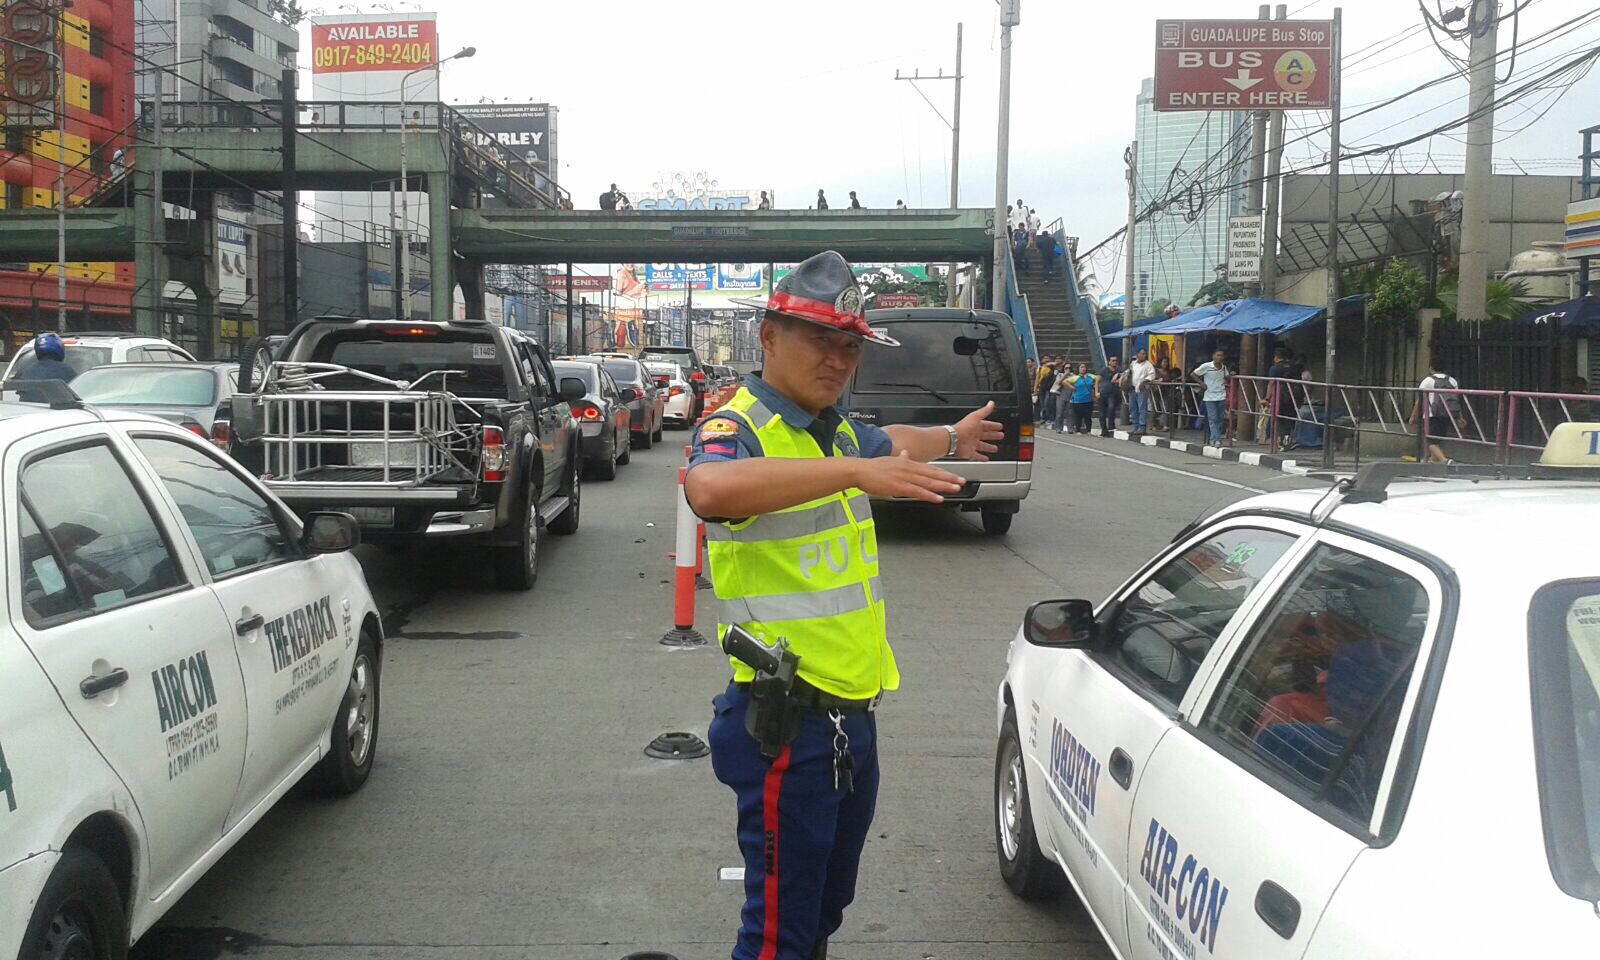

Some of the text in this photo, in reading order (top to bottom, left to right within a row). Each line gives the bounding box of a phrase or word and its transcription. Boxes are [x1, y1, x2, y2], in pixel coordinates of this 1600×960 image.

[328, 24, 418, 41] AVAILABLE
[1191, 28, 1266, 42] GUADALUPE
[1272, 28, 1294, 42] Bus
[1300, 27, 1325, 44] Stop
[315, 43, 430, 67] 0917-849-2404
[1178, 52, 1263, 68] BUS
[1286, 59, 1303, 70] A
[1287, 73, 1303, 84] C
[1169, 92, 1308, 105] ENTER HERE
[477, 132, 543, 146] BARLEY
[722, 280, 757, 288] Instagram
[1582, 430, 1600, 456] T
[264, 616, 292, 674] THE
[285, 607, 311, 662] RED
[305, 595, 338, 651] ROCK
[152, 650, 217, 733] AIRCON
[1140, 817, 1229, 955] AIR-CON
